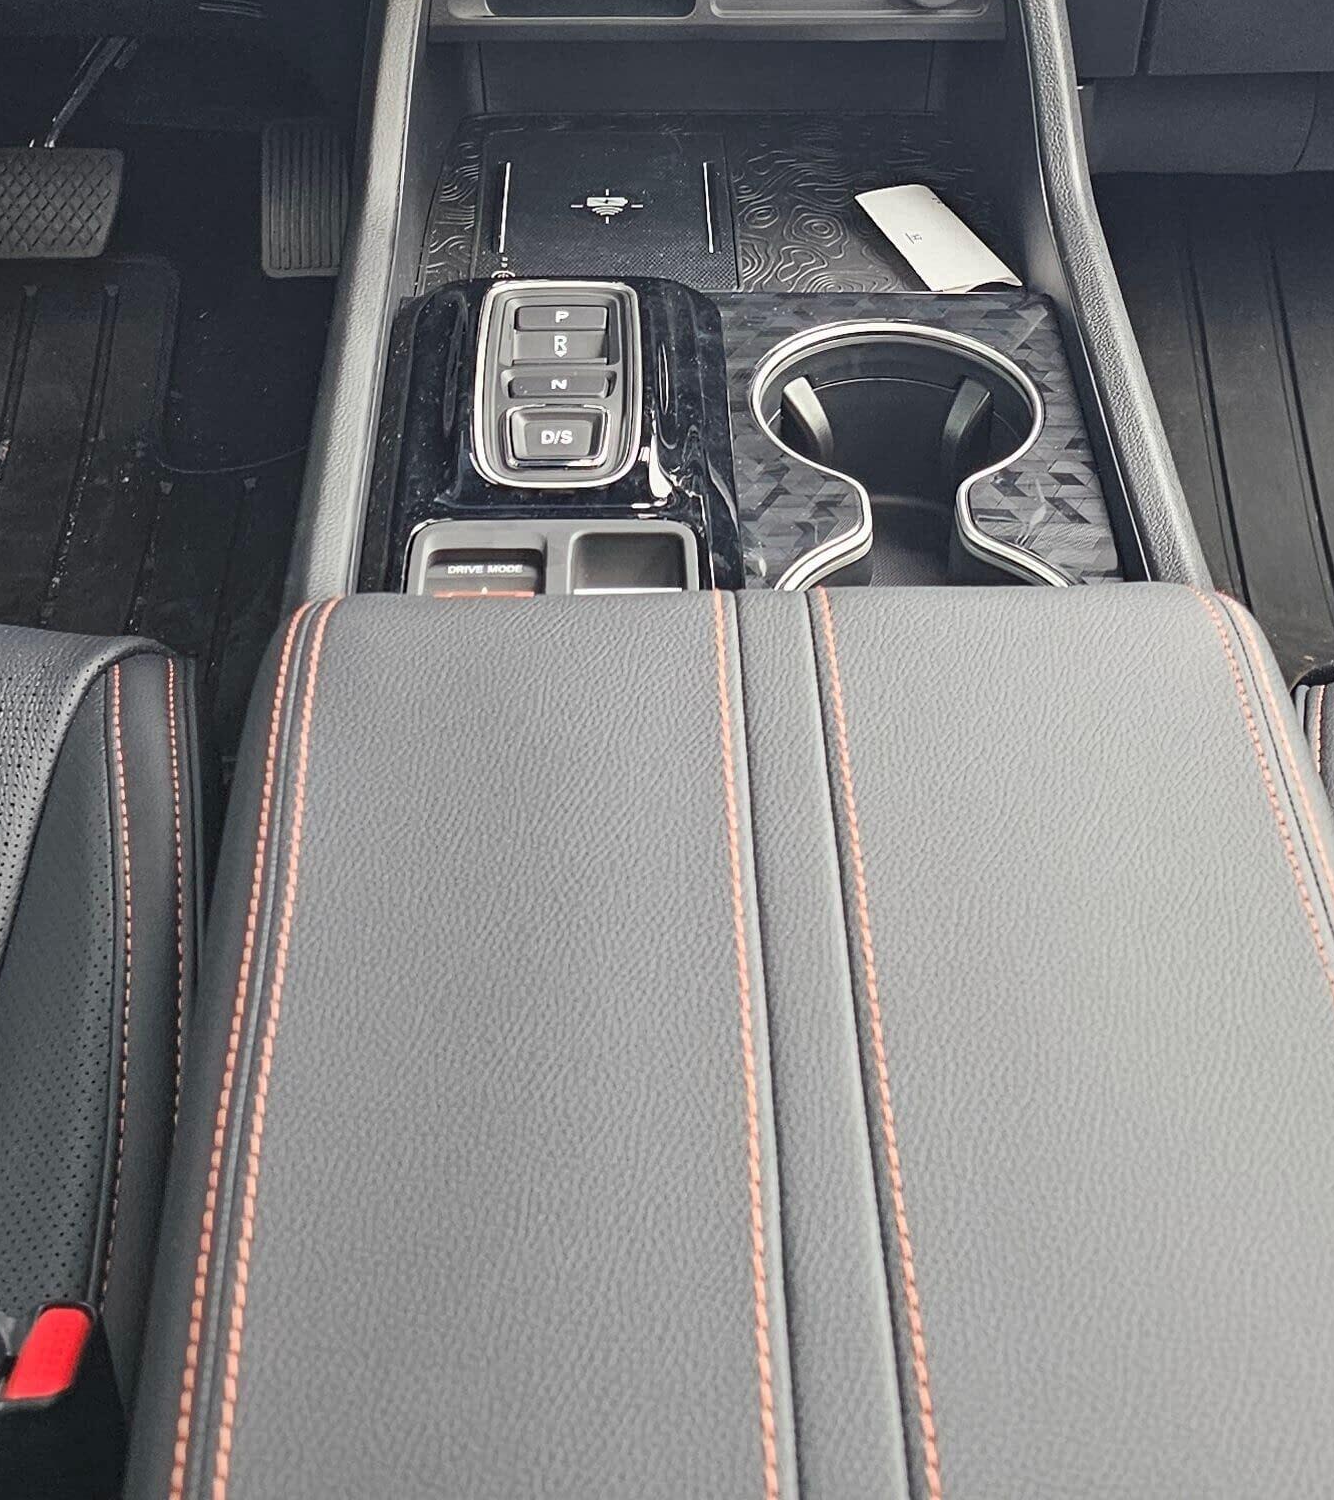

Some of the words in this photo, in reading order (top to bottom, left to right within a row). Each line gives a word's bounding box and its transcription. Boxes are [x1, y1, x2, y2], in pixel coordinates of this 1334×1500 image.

[555, 311, 569, 323] P
[554, 335, 567, 350] R
[551, 379, 567, 389] N
[541, 429, 573, 445] D/S
[447, 565, 483, 574] DRIVE
[487, 564, 523, 574] MODE
